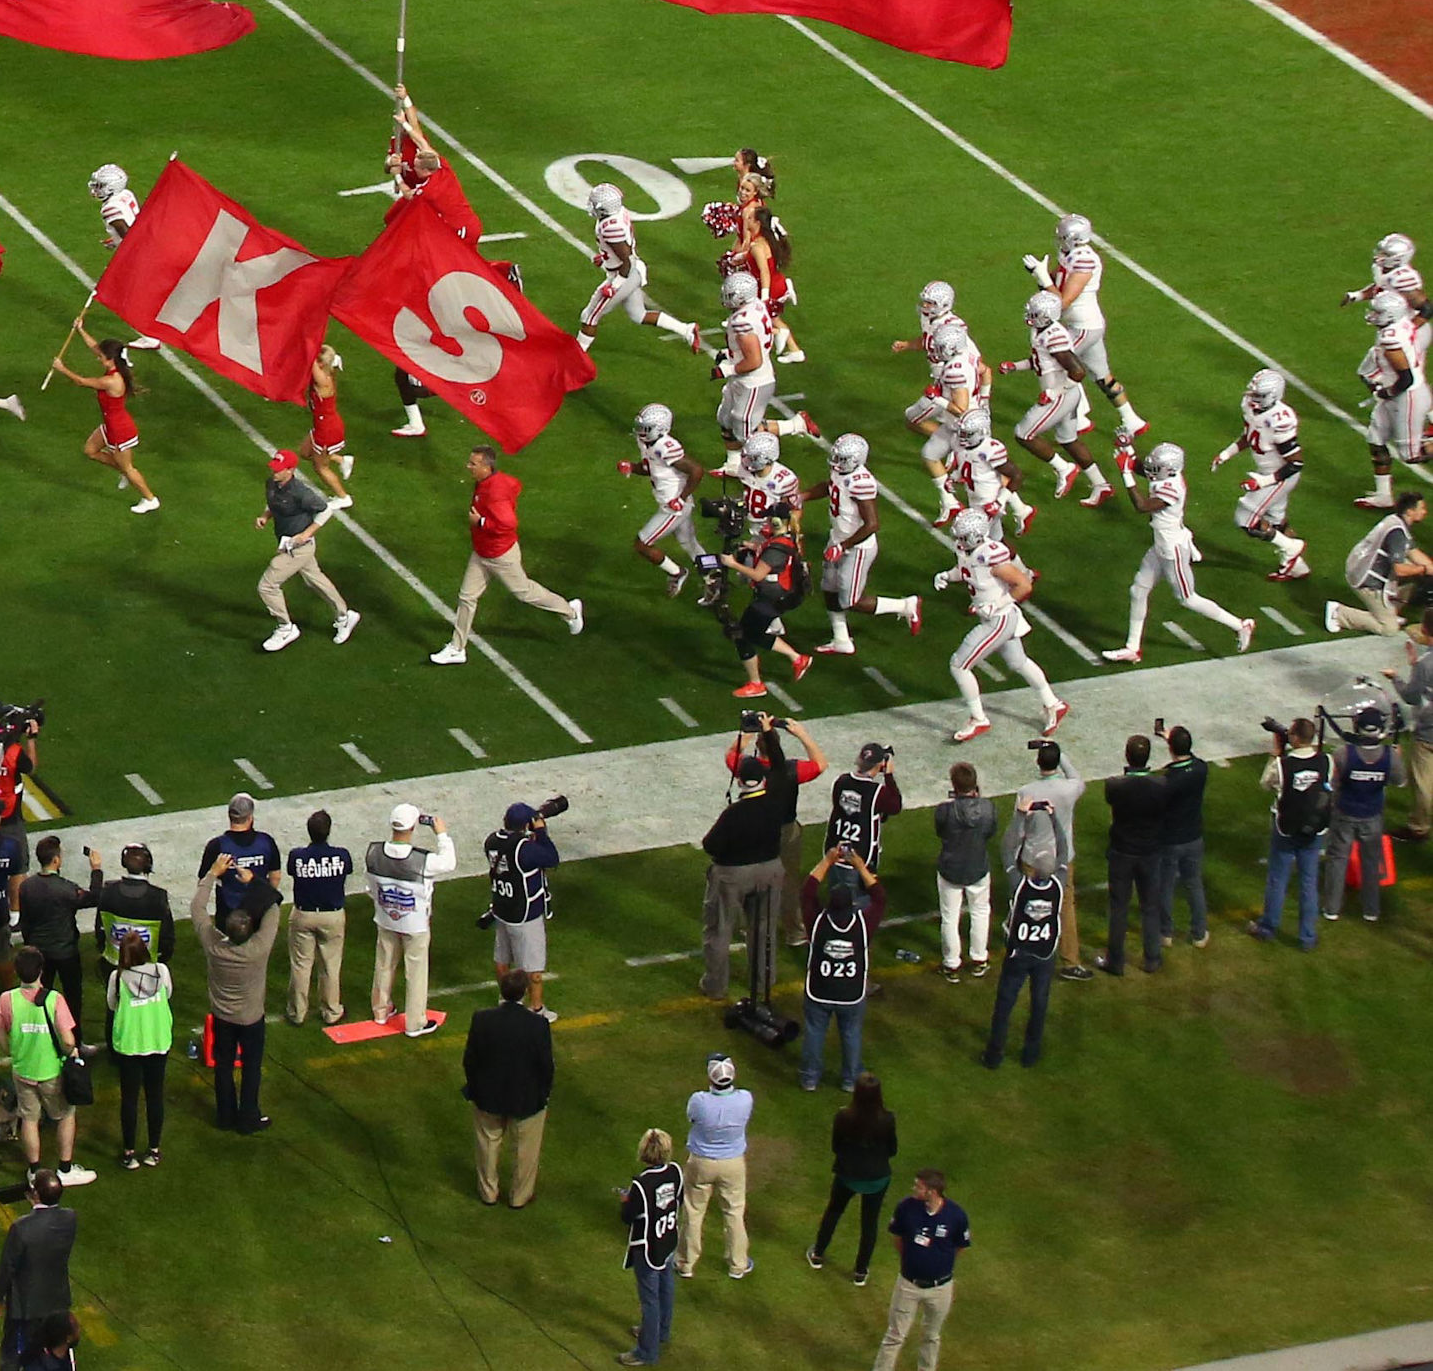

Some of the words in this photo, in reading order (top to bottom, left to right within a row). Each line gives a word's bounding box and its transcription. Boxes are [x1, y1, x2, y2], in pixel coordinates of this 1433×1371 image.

[156, 209, 318, 374] K
[393, 271, 527, 383] S
[835, 818, 861, 842] 122
[296, 864, 345, 879] SECURITY
[1017, 923, 1051, 942] 024
[820, 960, 857, 979] 023
